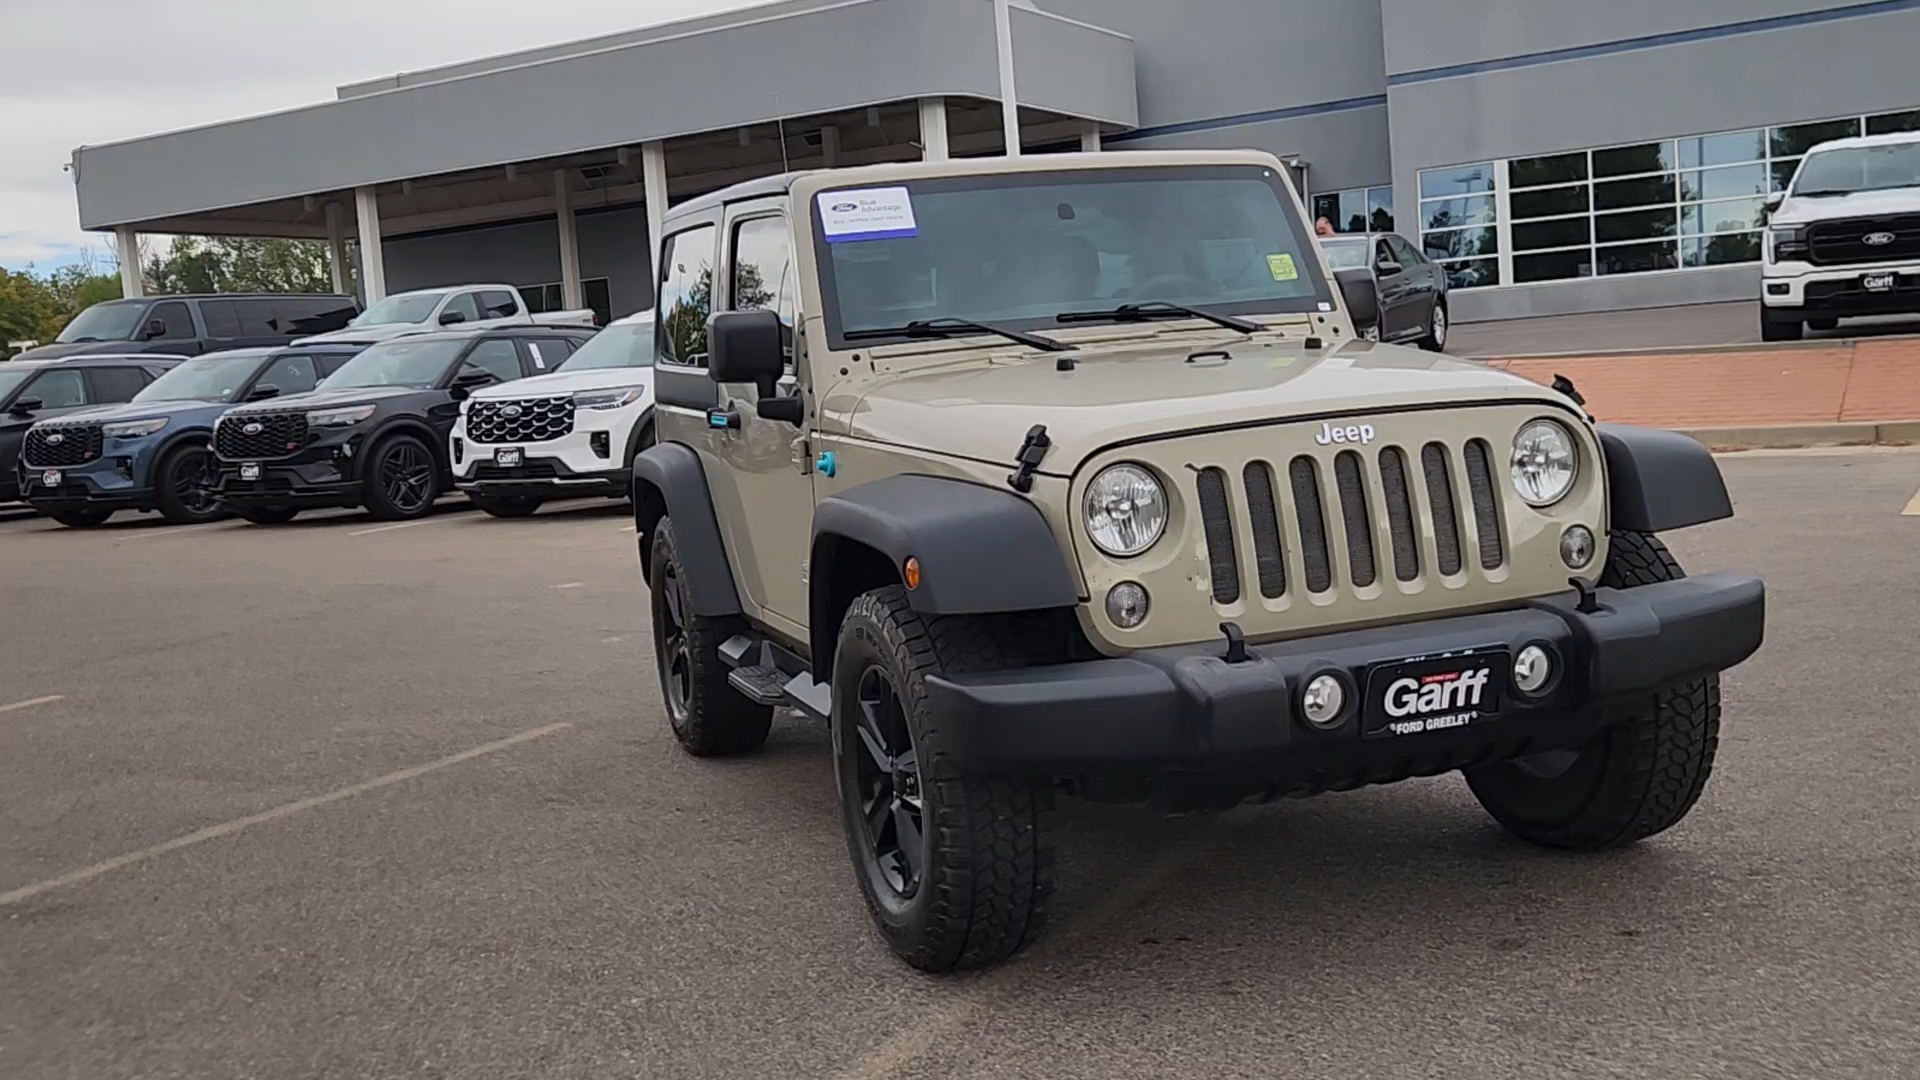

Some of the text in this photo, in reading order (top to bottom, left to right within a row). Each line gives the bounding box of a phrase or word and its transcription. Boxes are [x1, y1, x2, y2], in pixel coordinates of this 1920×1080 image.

[1863, 275, 1894, 288] Garff
[1315, 422, 1375, 445] Jeep
[1384, 668, 1490, 717] Garff
[1396, 713, 1471, 735] FORD GREELEY
